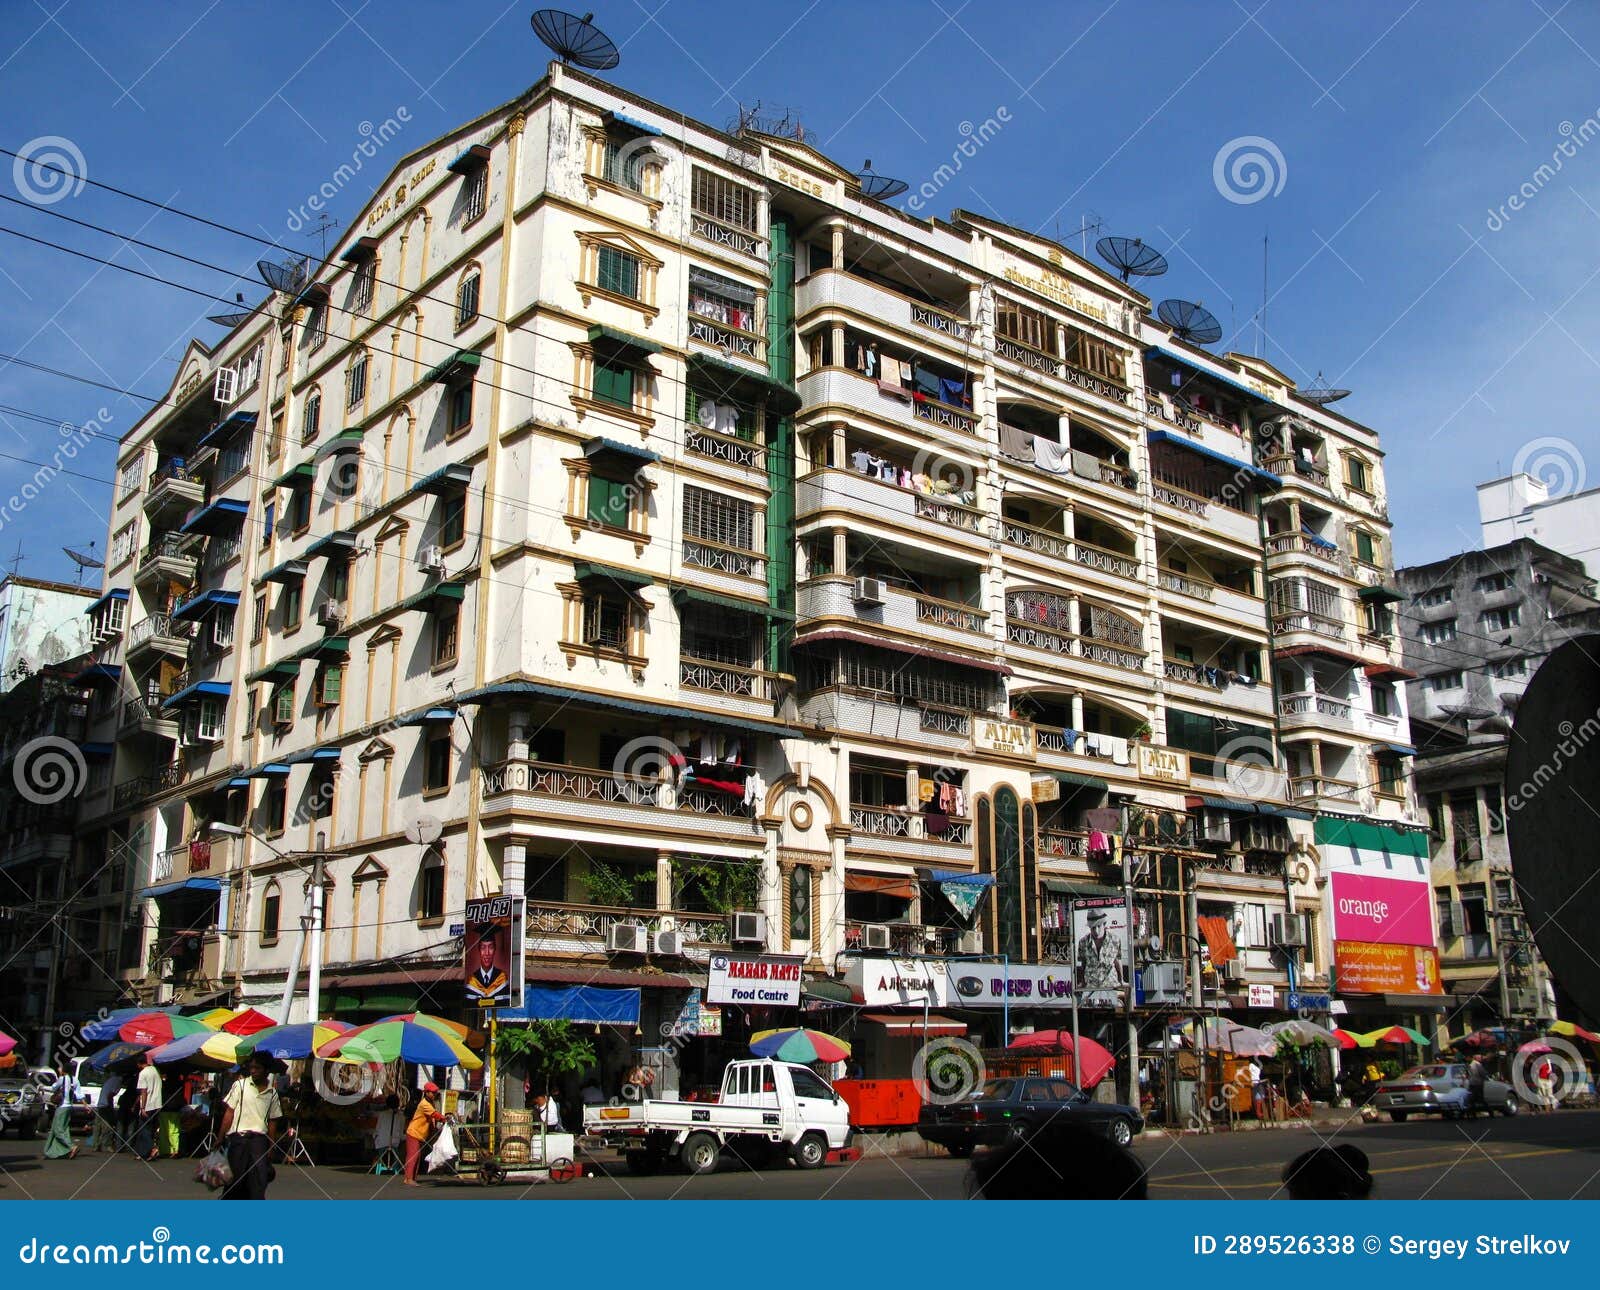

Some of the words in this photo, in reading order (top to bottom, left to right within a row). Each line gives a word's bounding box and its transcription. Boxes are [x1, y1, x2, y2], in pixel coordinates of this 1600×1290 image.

[984, 722, 1024, 746] MTM
[1148, 749, 1180, 772] MTM
[1339, 898, 1389, 924] orange
[732, 988, 756, 1000] Food
[758, 989, 789, 1001] Centre
